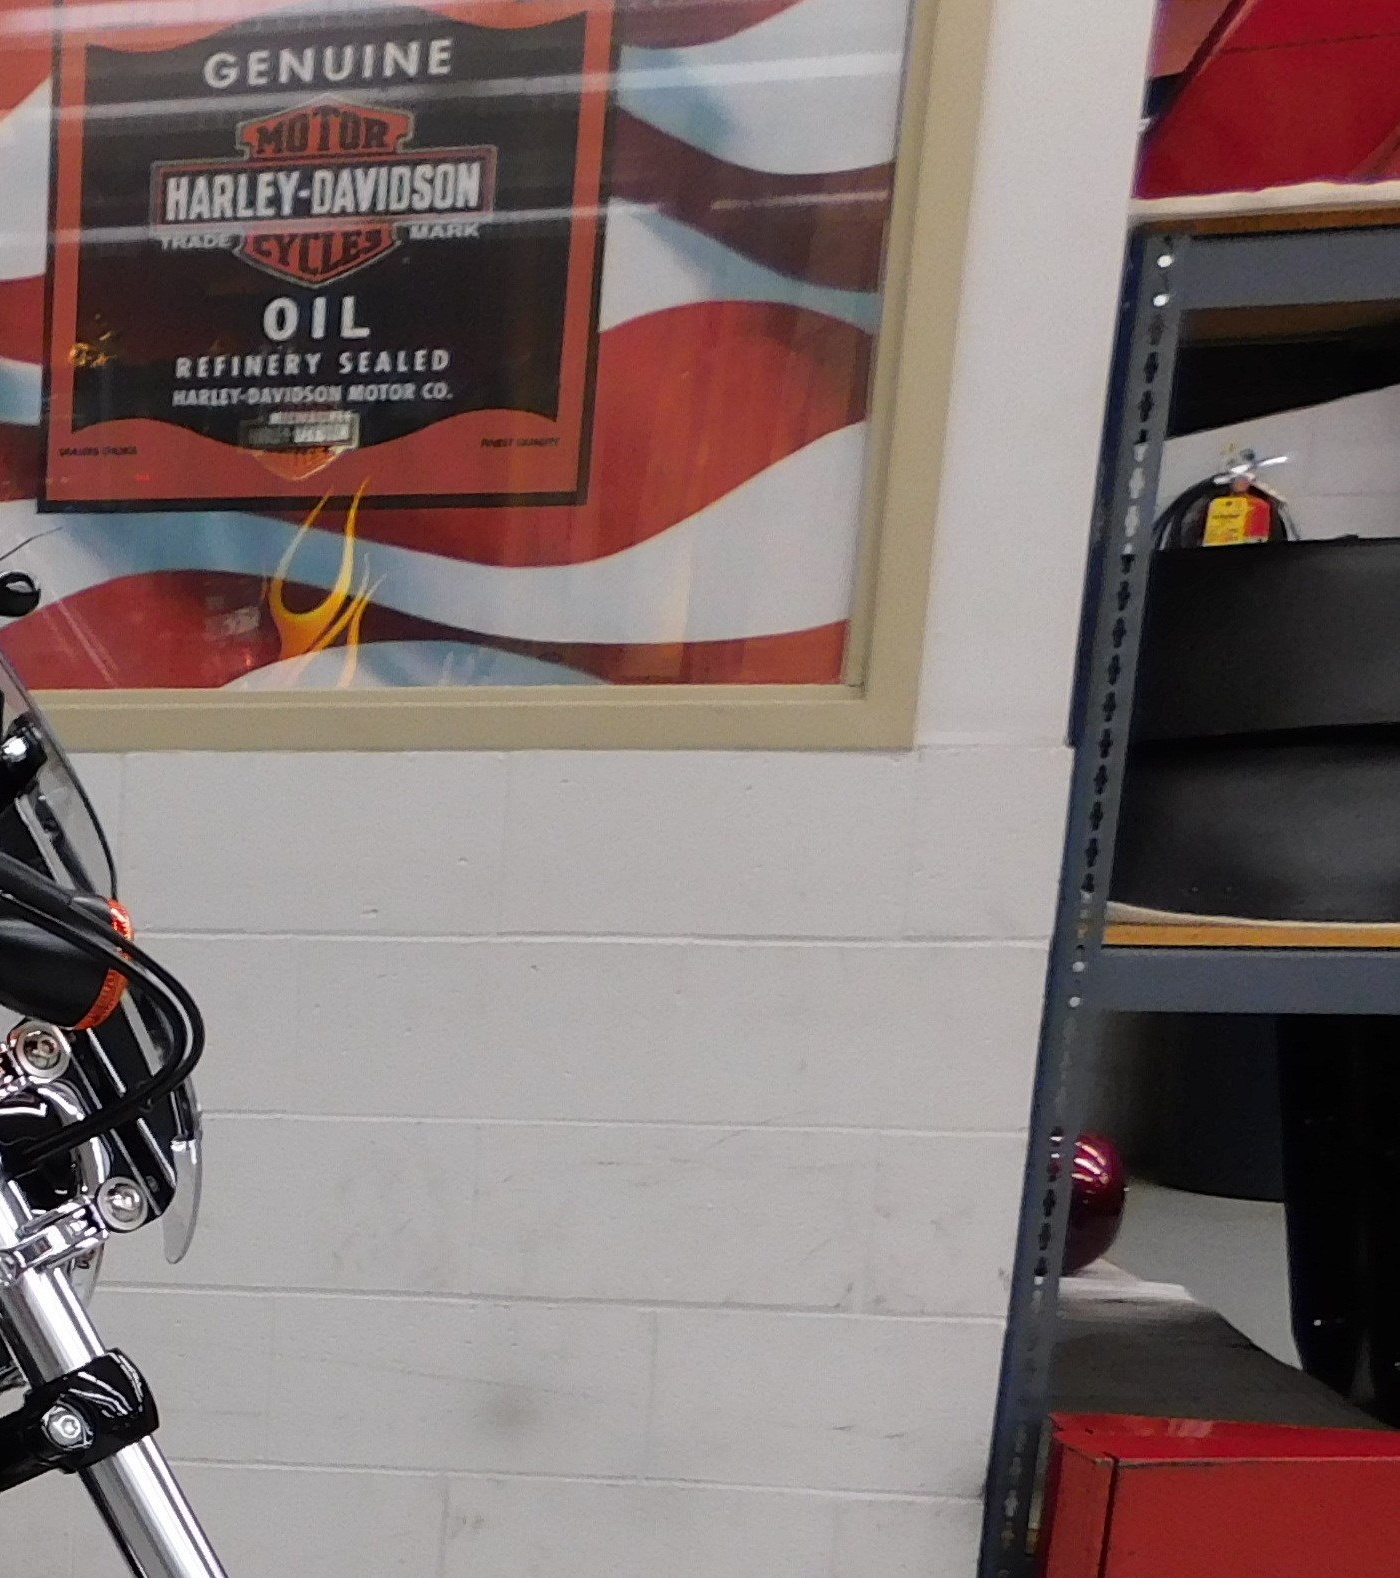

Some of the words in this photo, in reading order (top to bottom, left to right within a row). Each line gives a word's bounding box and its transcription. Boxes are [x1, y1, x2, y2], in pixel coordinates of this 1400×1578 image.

[204, 38, 454, 89] GENUINE
[255, 106, 390, 155] MOTOR
[165, 162, 483, 223] HARLEY-DAVIDSON
[160, 233, 232, 252] TRADE
[254, 226, 385, 279] CYCLES
[409, 222, 481, 241] MARK
[262, 296, 372, 342] OIL
[174, 353, 322, 379] REFINERY
[338, 349, 452, 375] SEALED
[171, 386, 343, 407] HARLEY-DAVIDSON
[347, 383, 418, 404] MOTOR
[421, 382, 455, 402] CO.
